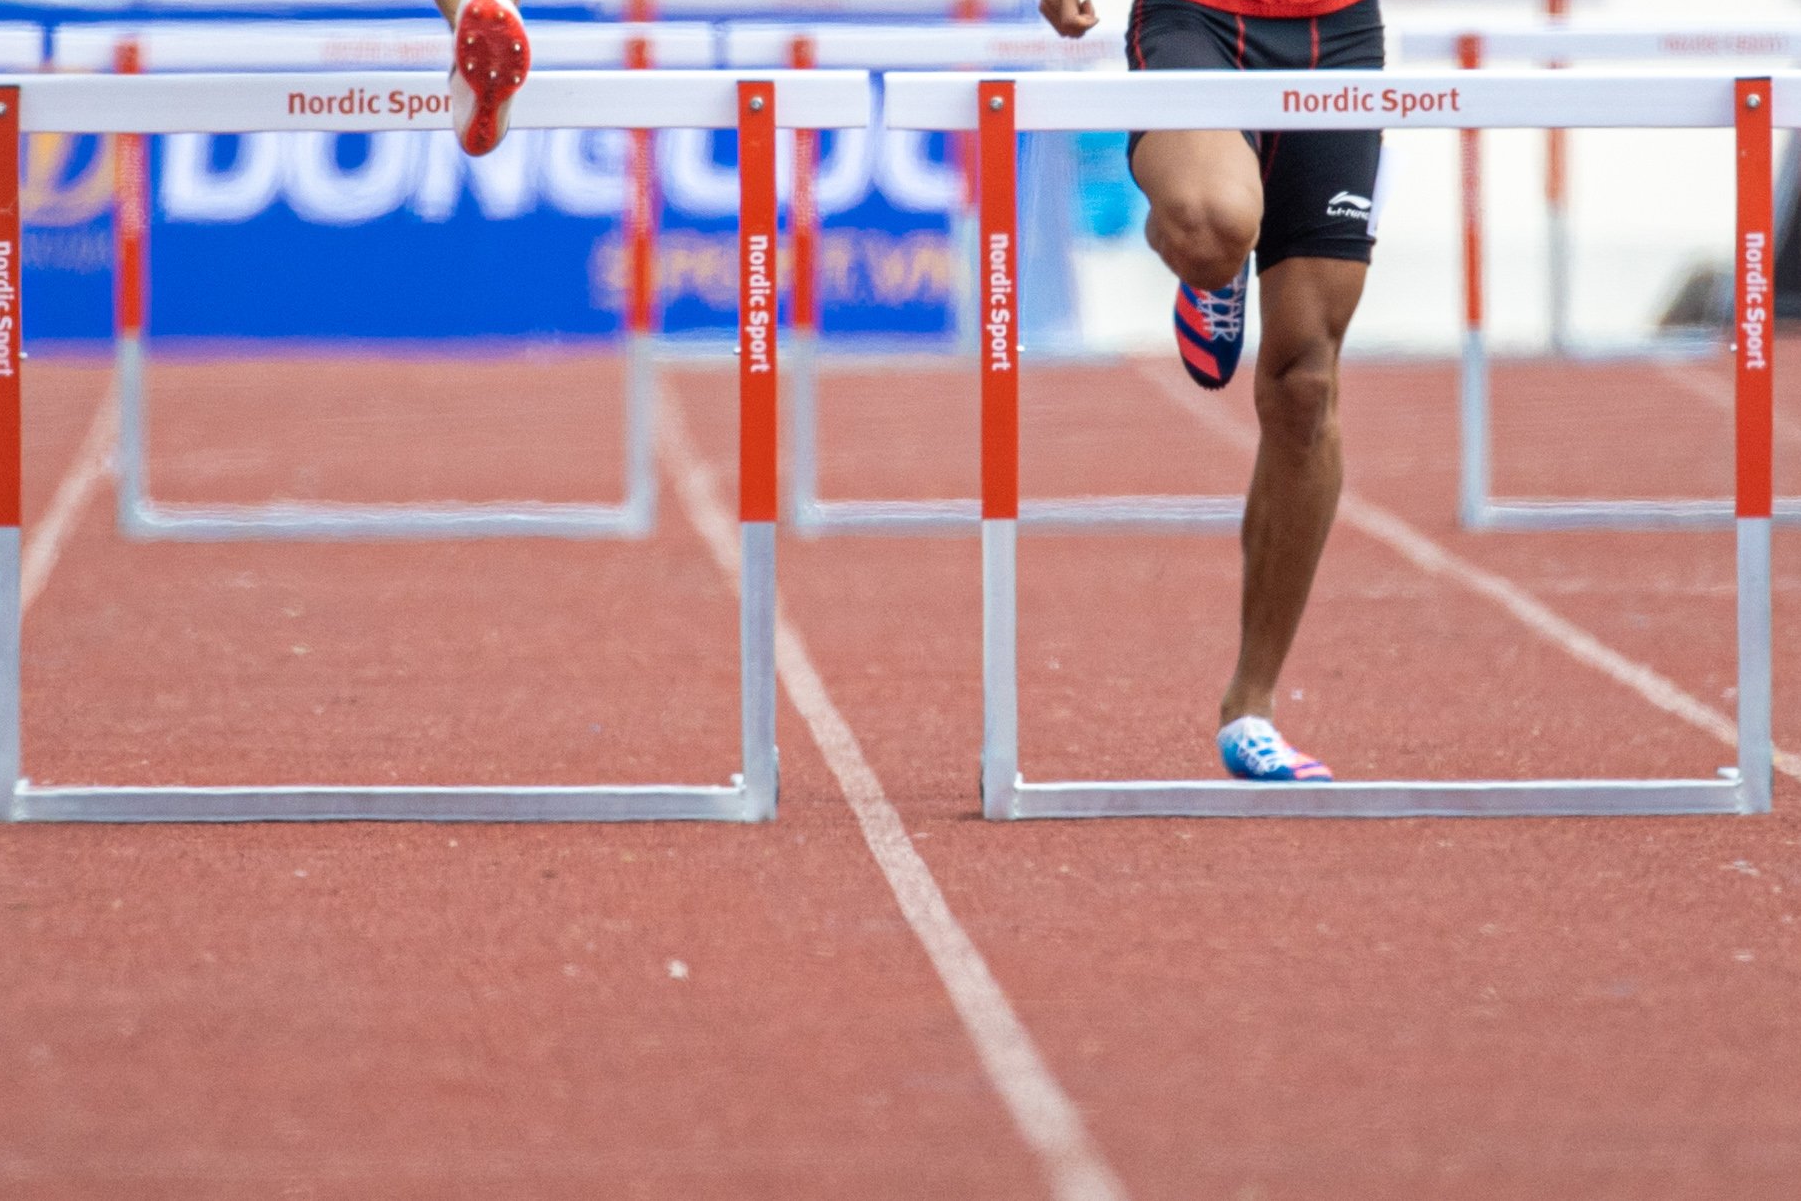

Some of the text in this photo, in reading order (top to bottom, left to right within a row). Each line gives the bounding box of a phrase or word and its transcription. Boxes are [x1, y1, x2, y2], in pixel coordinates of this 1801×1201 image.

[387, 89, 453, 120] Spor
[1381, 87, 1461, 119] Sport
[744, 310, 771, 374] Sport
[985, 307, 1012, 372] Sport
[1741, 307, 1767, 370] Sport
